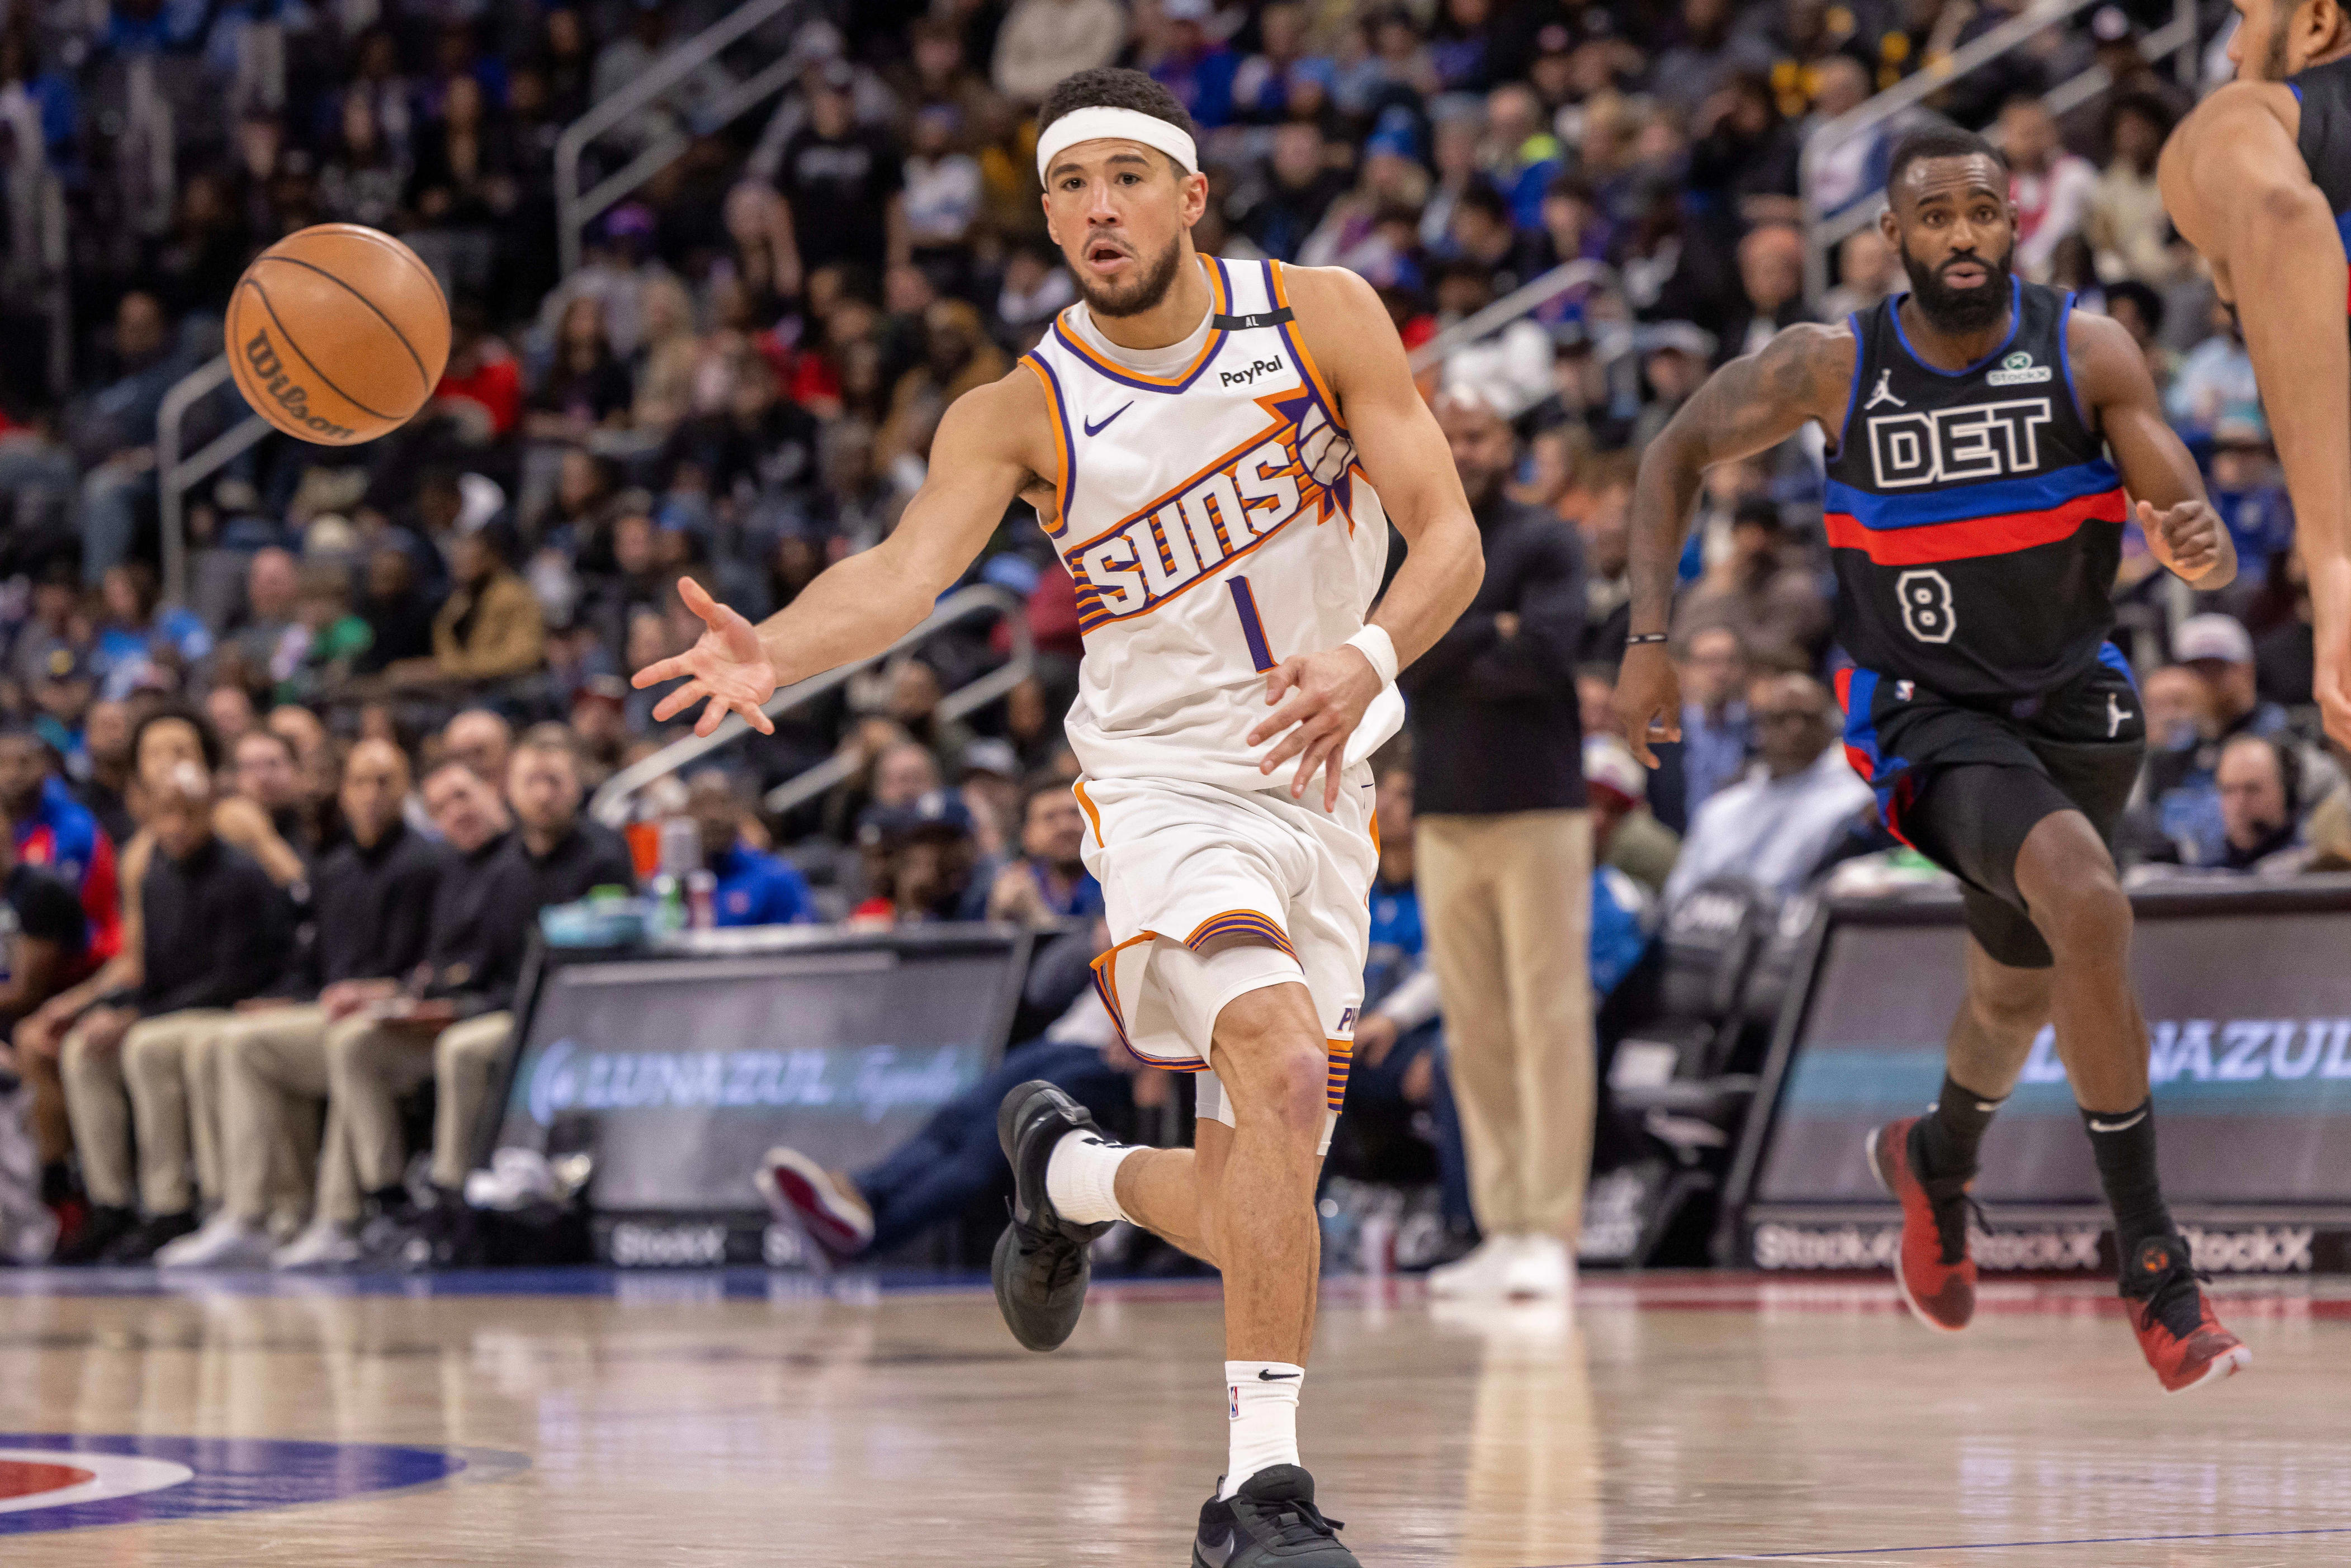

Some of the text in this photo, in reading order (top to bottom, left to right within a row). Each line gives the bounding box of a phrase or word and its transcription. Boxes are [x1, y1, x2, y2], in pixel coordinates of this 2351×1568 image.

[1246, 315, 1259, 328] AL
[247, 328, 354, 438] Wilson
[1219, 354, 1283, 387] PayPal
[1867, 397, 2051, 488] DET
[1081, 440, 1300, 615] SUNS
[1224, 574, 1280, 674] 1
[1896, 569, 1956, 643] 8
[2019, 1019, 2351, 1082] LNAZUL
